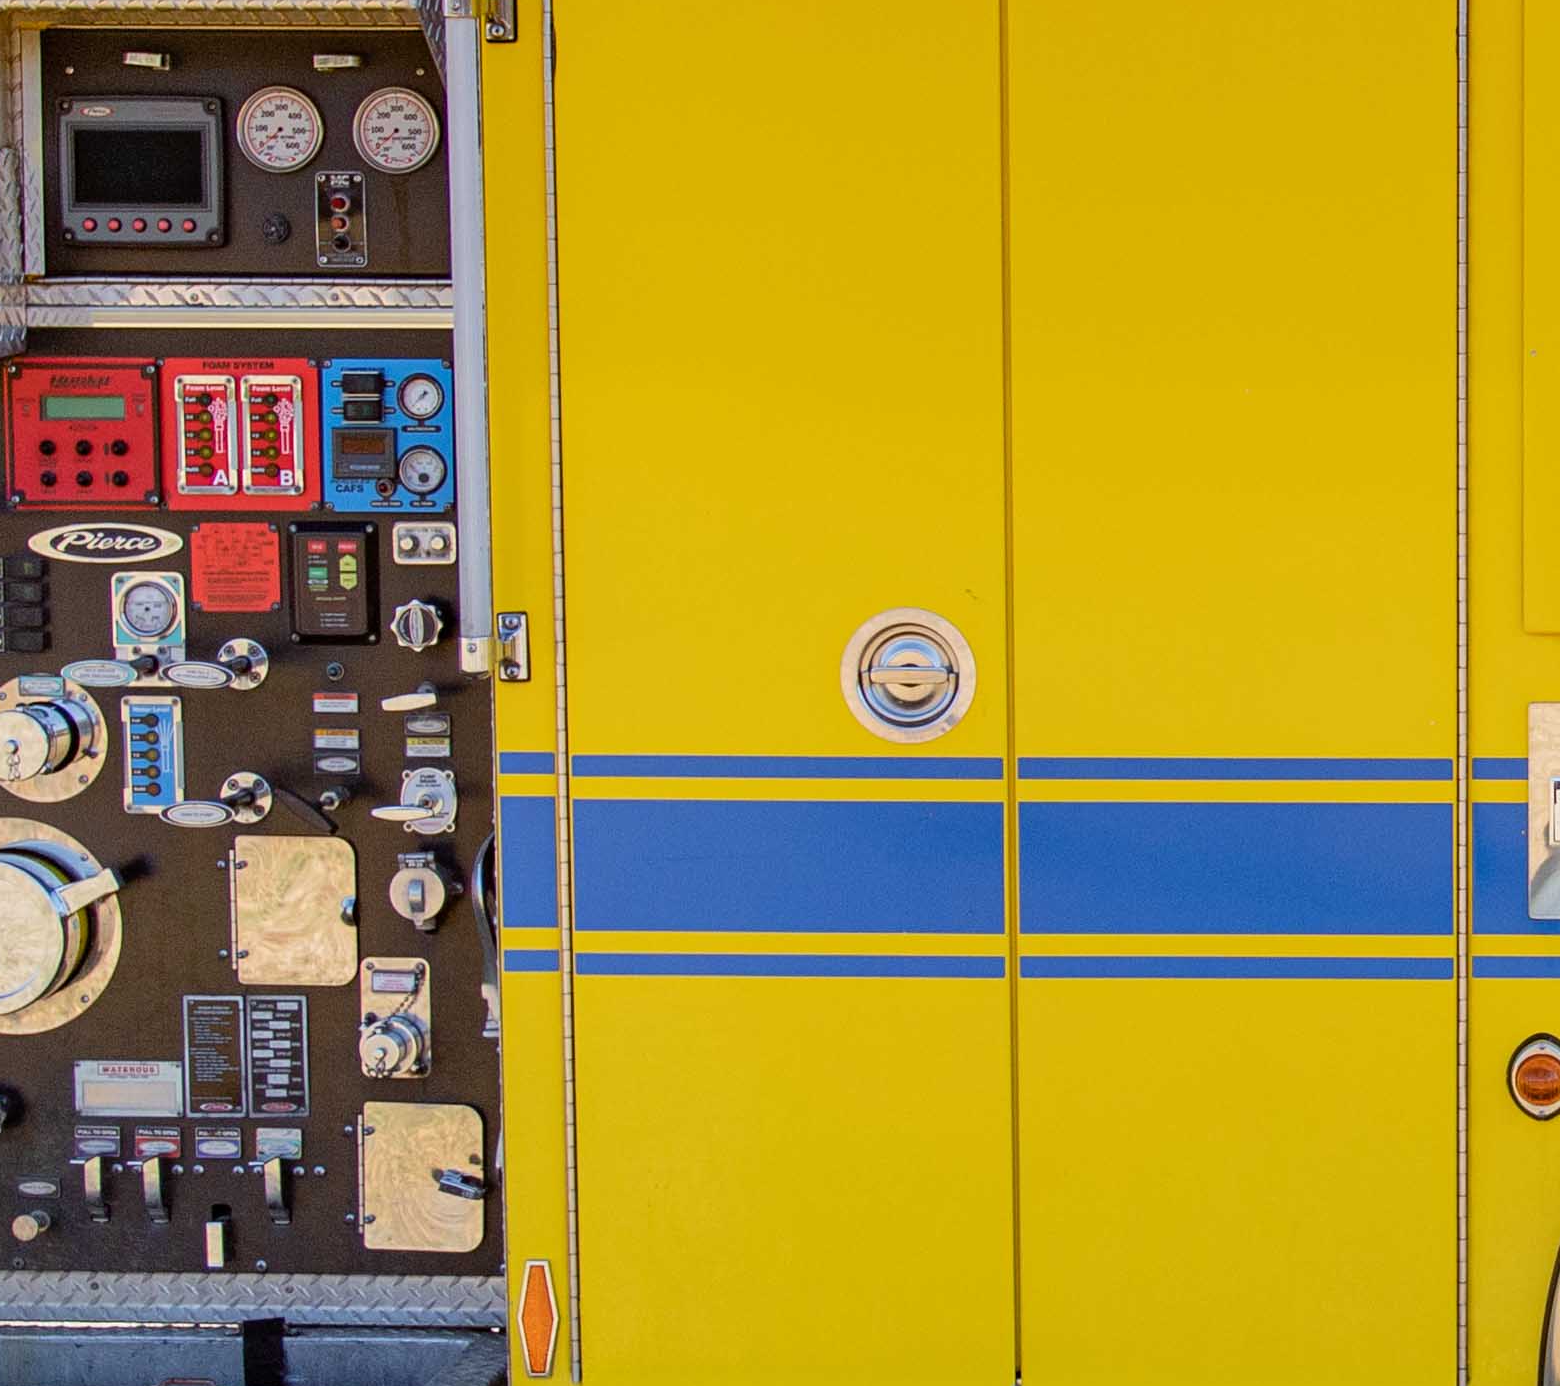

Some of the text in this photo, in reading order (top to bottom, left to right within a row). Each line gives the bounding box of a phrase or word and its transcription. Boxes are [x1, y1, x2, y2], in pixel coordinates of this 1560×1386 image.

[202, 361, 274, 370] FOAM SYSTEM
[213, 469, 229, 486] A
[280, 470, 294, 486] B
[336, 484, 364, 494] CAFS
[56, 530, 157, 552] Pierce
[102, 1066, 156, 1074] WATEROUS
